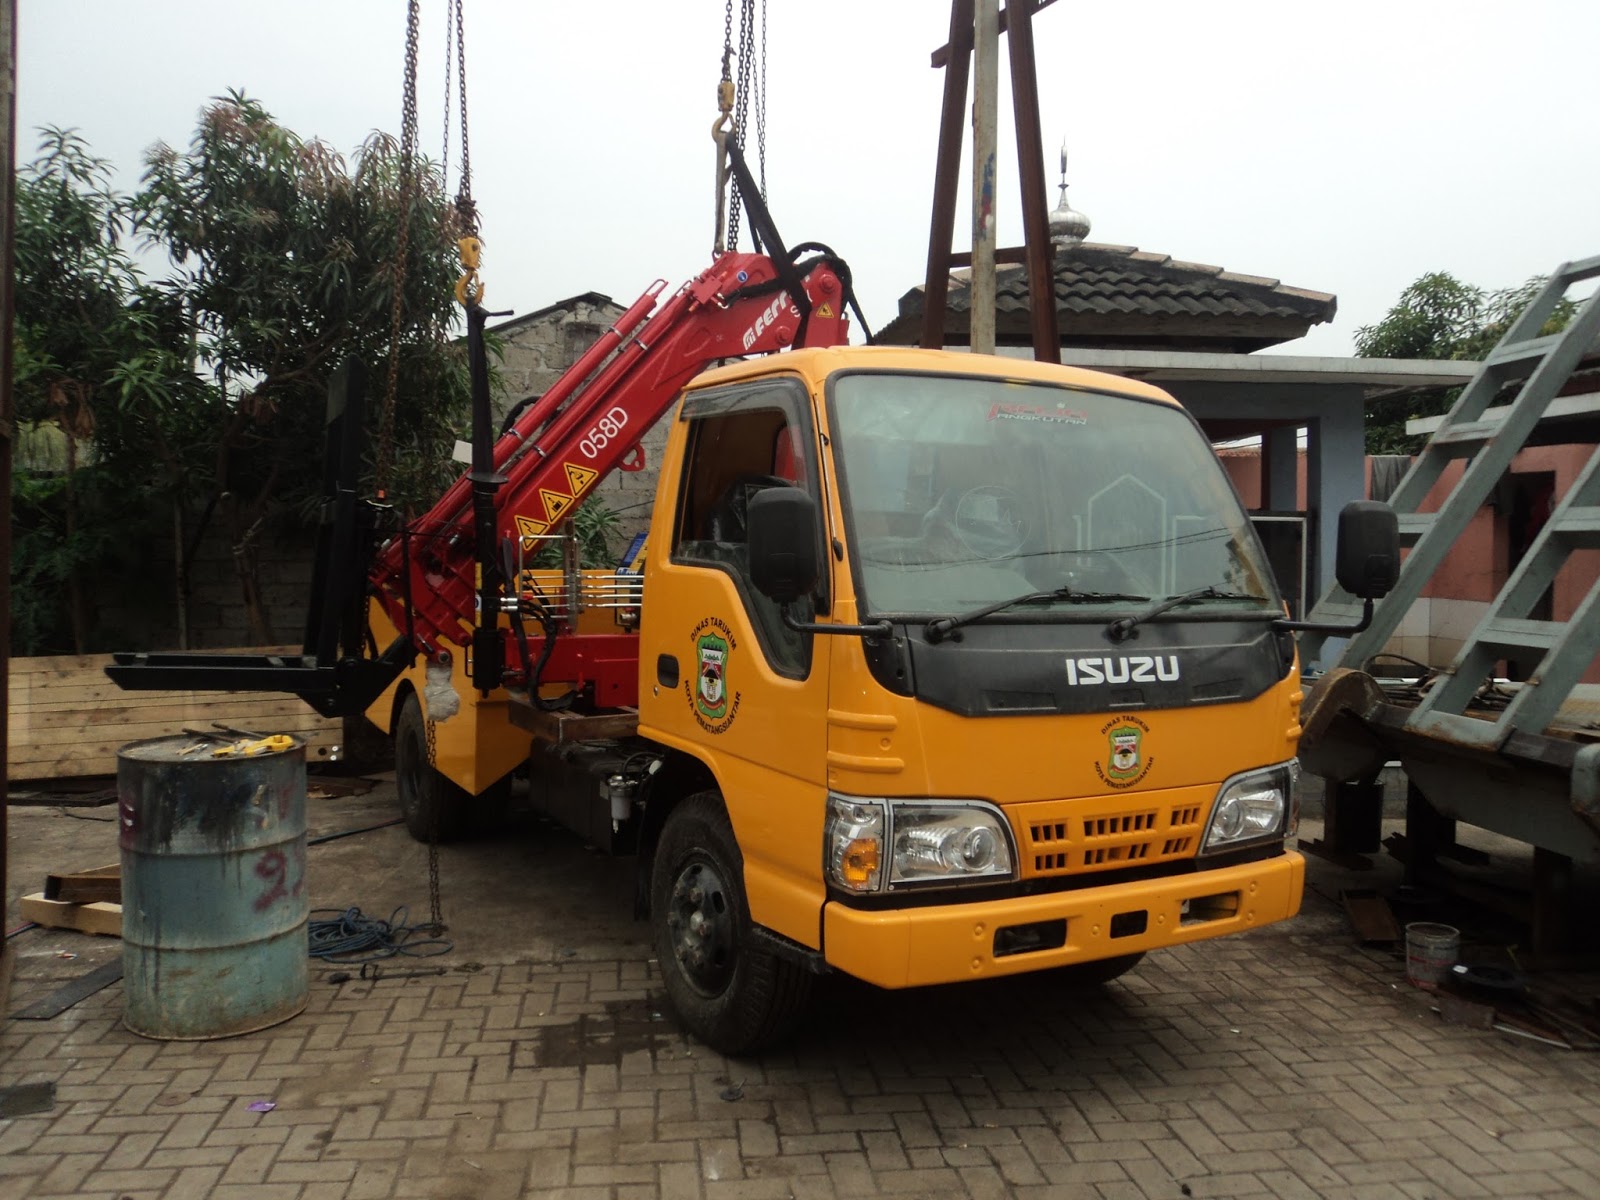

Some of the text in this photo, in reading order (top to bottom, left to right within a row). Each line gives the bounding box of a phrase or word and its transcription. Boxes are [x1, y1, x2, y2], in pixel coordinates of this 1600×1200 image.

[579, 406, 629, 459] 058D
[997, 413, 1088, 426] ANGKUTAN
[690, 617, 738, 651] DINAS TARUKIM
[1065, 655, 1180, 686] ISUZU
[684, 679, 742, 735] KOTA PEMATANGSIANTAR
[1101, 717, 1120, 735] DINAS
